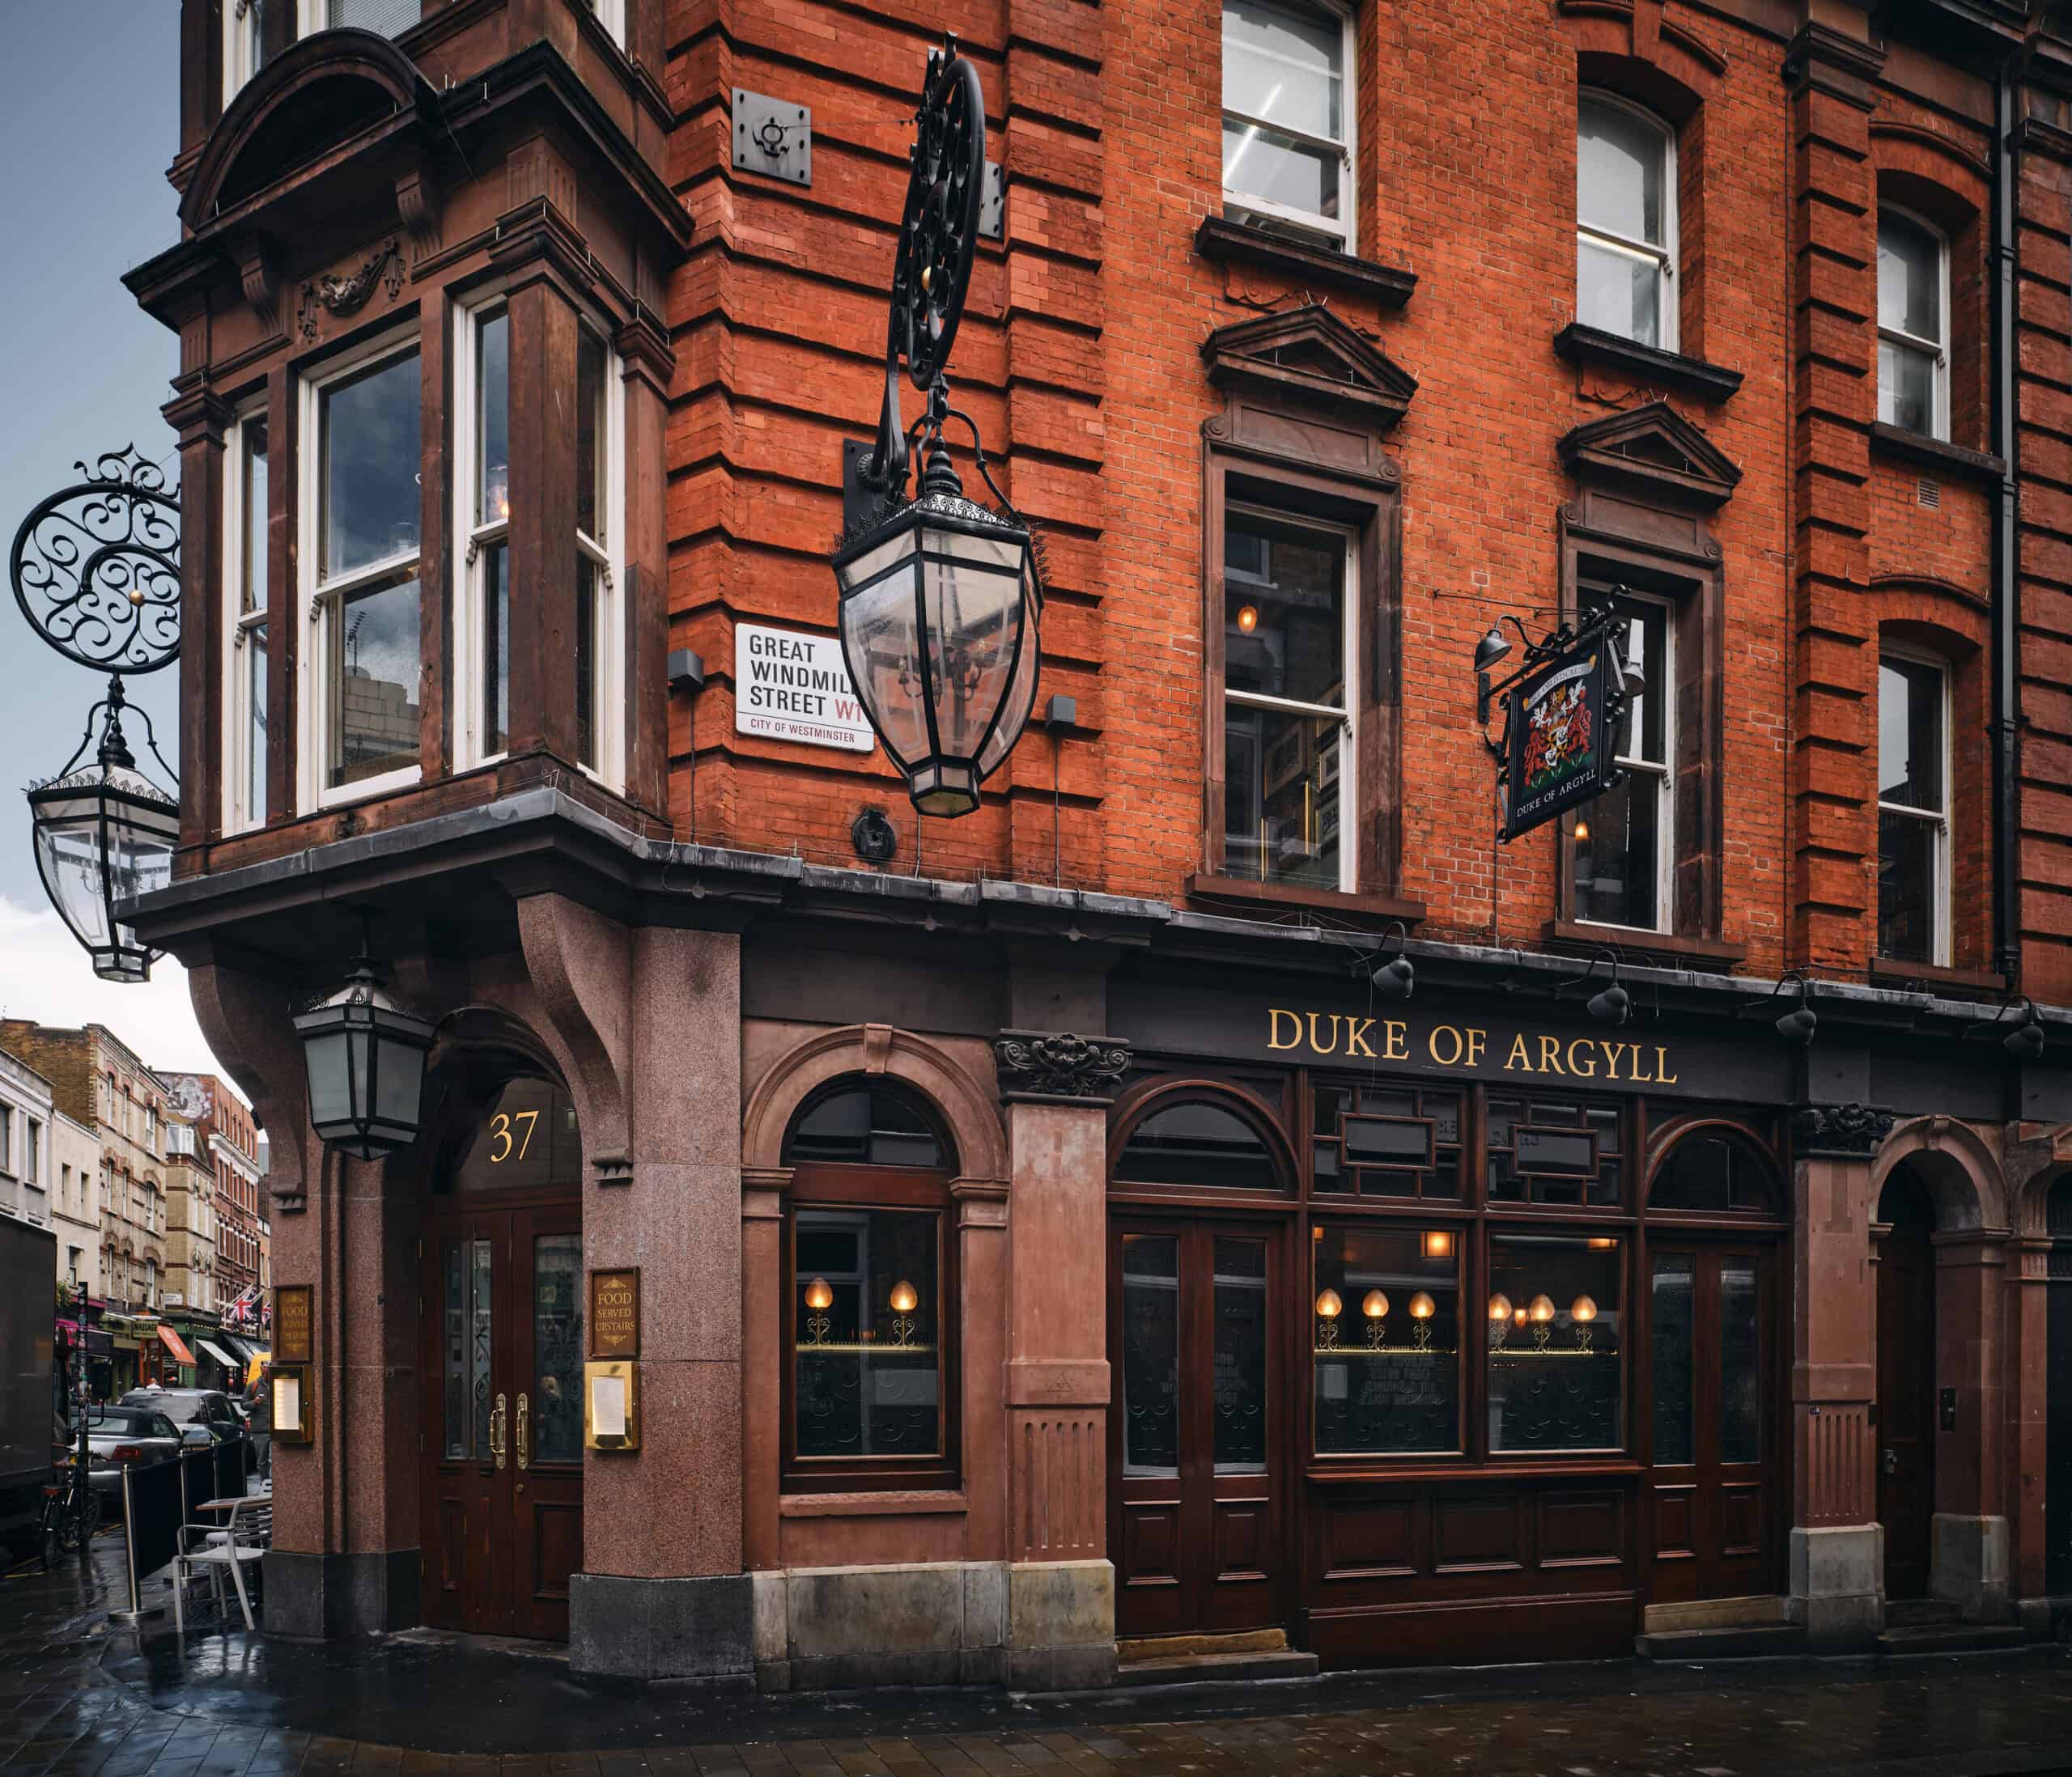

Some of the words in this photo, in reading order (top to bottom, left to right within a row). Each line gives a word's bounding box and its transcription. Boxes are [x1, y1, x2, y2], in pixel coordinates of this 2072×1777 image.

[749, 634, 815, 663] GREAT
[750, 685, 826, 716] STREET
[835, 698, 862, 722] W1
[750, 718, 771, 729] CITY
[775, 721, 786, 732] OF
[789, 723, 855, 743] WESTMINSTER
[1516, 796, 1541, 818] DUKE
[1543, 789, 1556, 804] OF
[1560, 769, 1597, 796] ARGYLL
[1267, 1008, 1410, 1061] DUKE
[1429, 1024, 1487, 1067] OF
[1503, 1033, 1678, 1084] ARGYLL
[490, 1109, 539, 1163] 37
[282, 1306, 308, 1317] FOOD
[598, 1292, 632, 1305] FOOD
[596, 1321, 635, 1332] UPSTAIRS
[597, 1308, 631, 1318] SERVED
